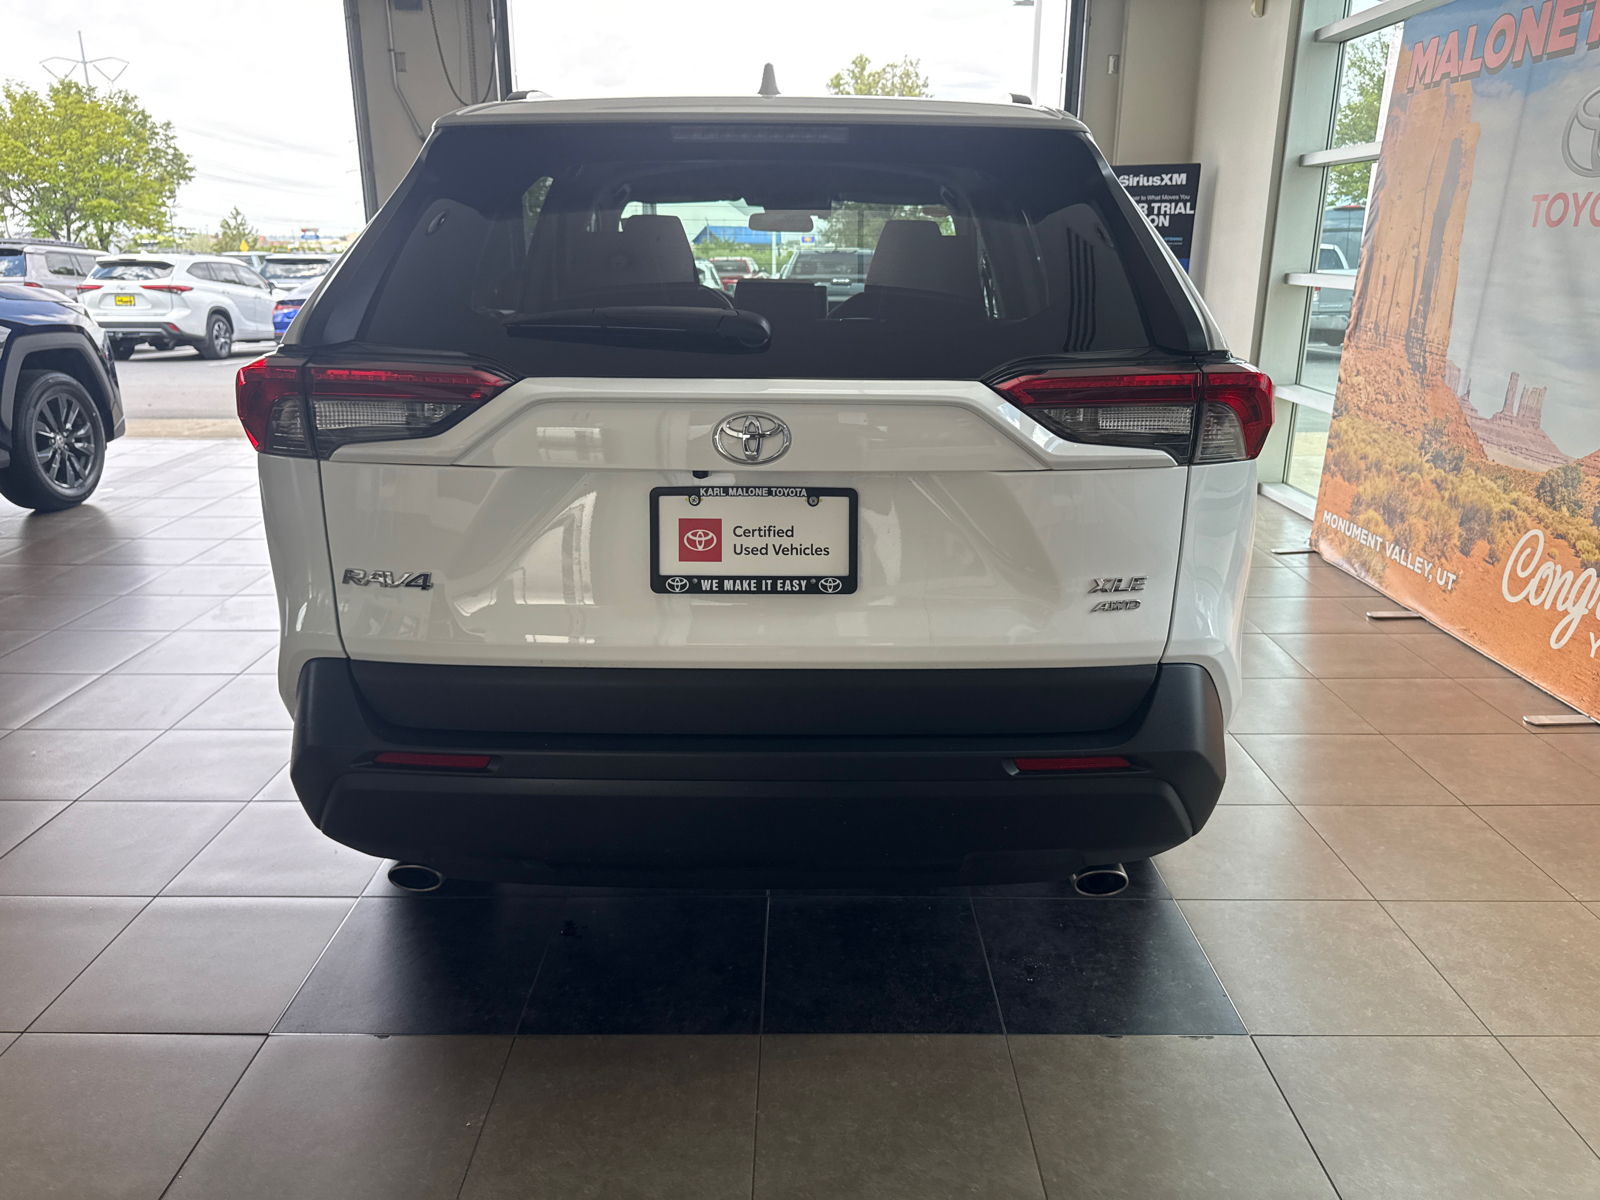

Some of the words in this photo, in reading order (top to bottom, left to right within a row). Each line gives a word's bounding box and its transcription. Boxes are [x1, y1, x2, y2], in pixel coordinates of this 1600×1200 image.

[1406, 0, 1584, 93] MALONE
[1119, 173, 1187, 187] SiriusXM
[1151, 202, 1195, 215] TRIAL
[700, 488, 726, 497] KARL
[728, 488, 769, 497] MALONE
[770, 488, 807, 497] TOYOTA
[733, 525, 795, 538] Certified
[733, 543, 769, 556] Used
[772, 543, 830, 556] Vehicles
[1322, 510, 1384, 552] MONUMENT
[1385, 540, 1433, 583] VALLEY,
[1436, 569, 1457, 590] UT
[342, 568, 434, 591] RAV4
[701, 579, 719, 591] WE
[723, 579, 757, 591] MAKE
[761, 579, 774, 591] IT
[777, 579, 807, 591] EASY
[1087, 576, 1148, 594] XLE
[1090, 599, 1141, 613] AWD
